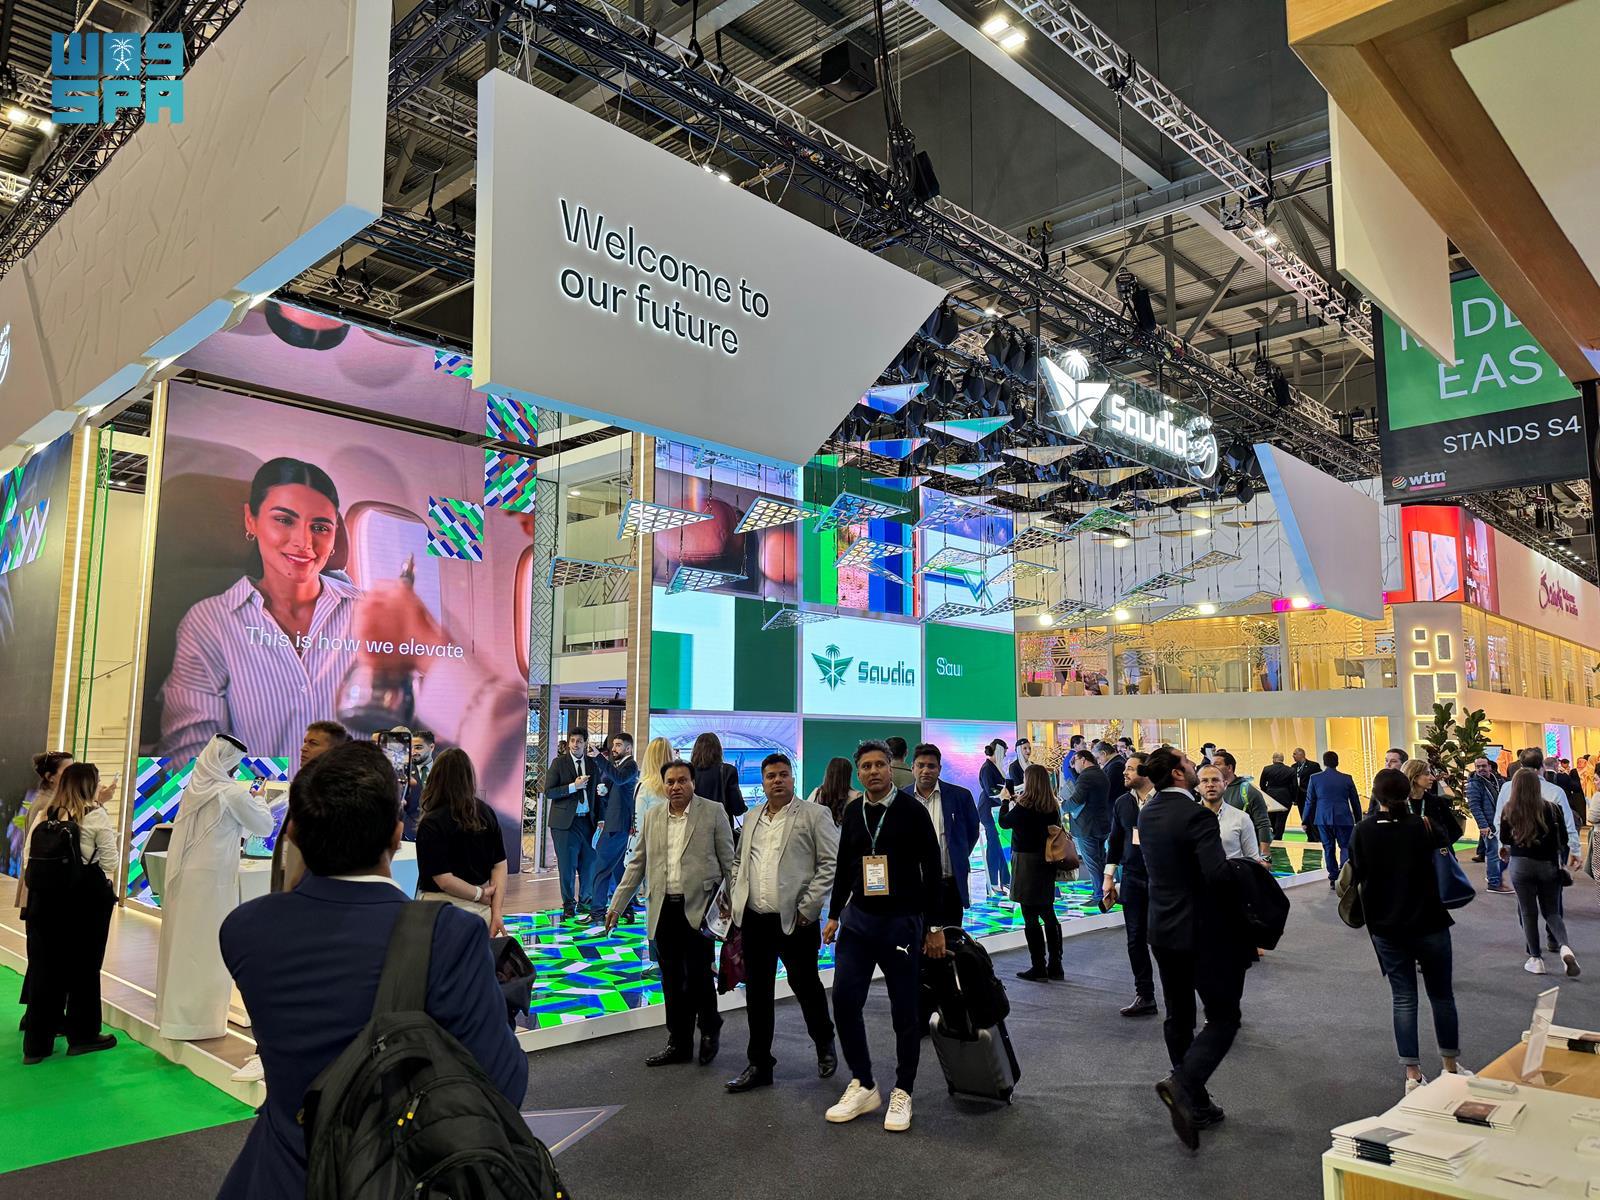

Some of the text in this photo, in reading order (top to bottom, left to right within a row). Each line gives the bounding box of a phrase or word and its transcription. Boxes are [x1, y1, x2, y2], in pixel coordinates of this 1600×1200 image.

[560, 198, 770, 318] Welcome to
[560, 268, 739, 355] our future
[1438, 344, 1566, 400] EAS
[1109, 394, 1187, 458] Saudia
[1443, 415, 1582, 454] STANDS S4
[1409, 471, 1446, 486] wtm
[245, 626, 464, 658] This is how we elevate
[858, 660, 915, 686] Saudia
